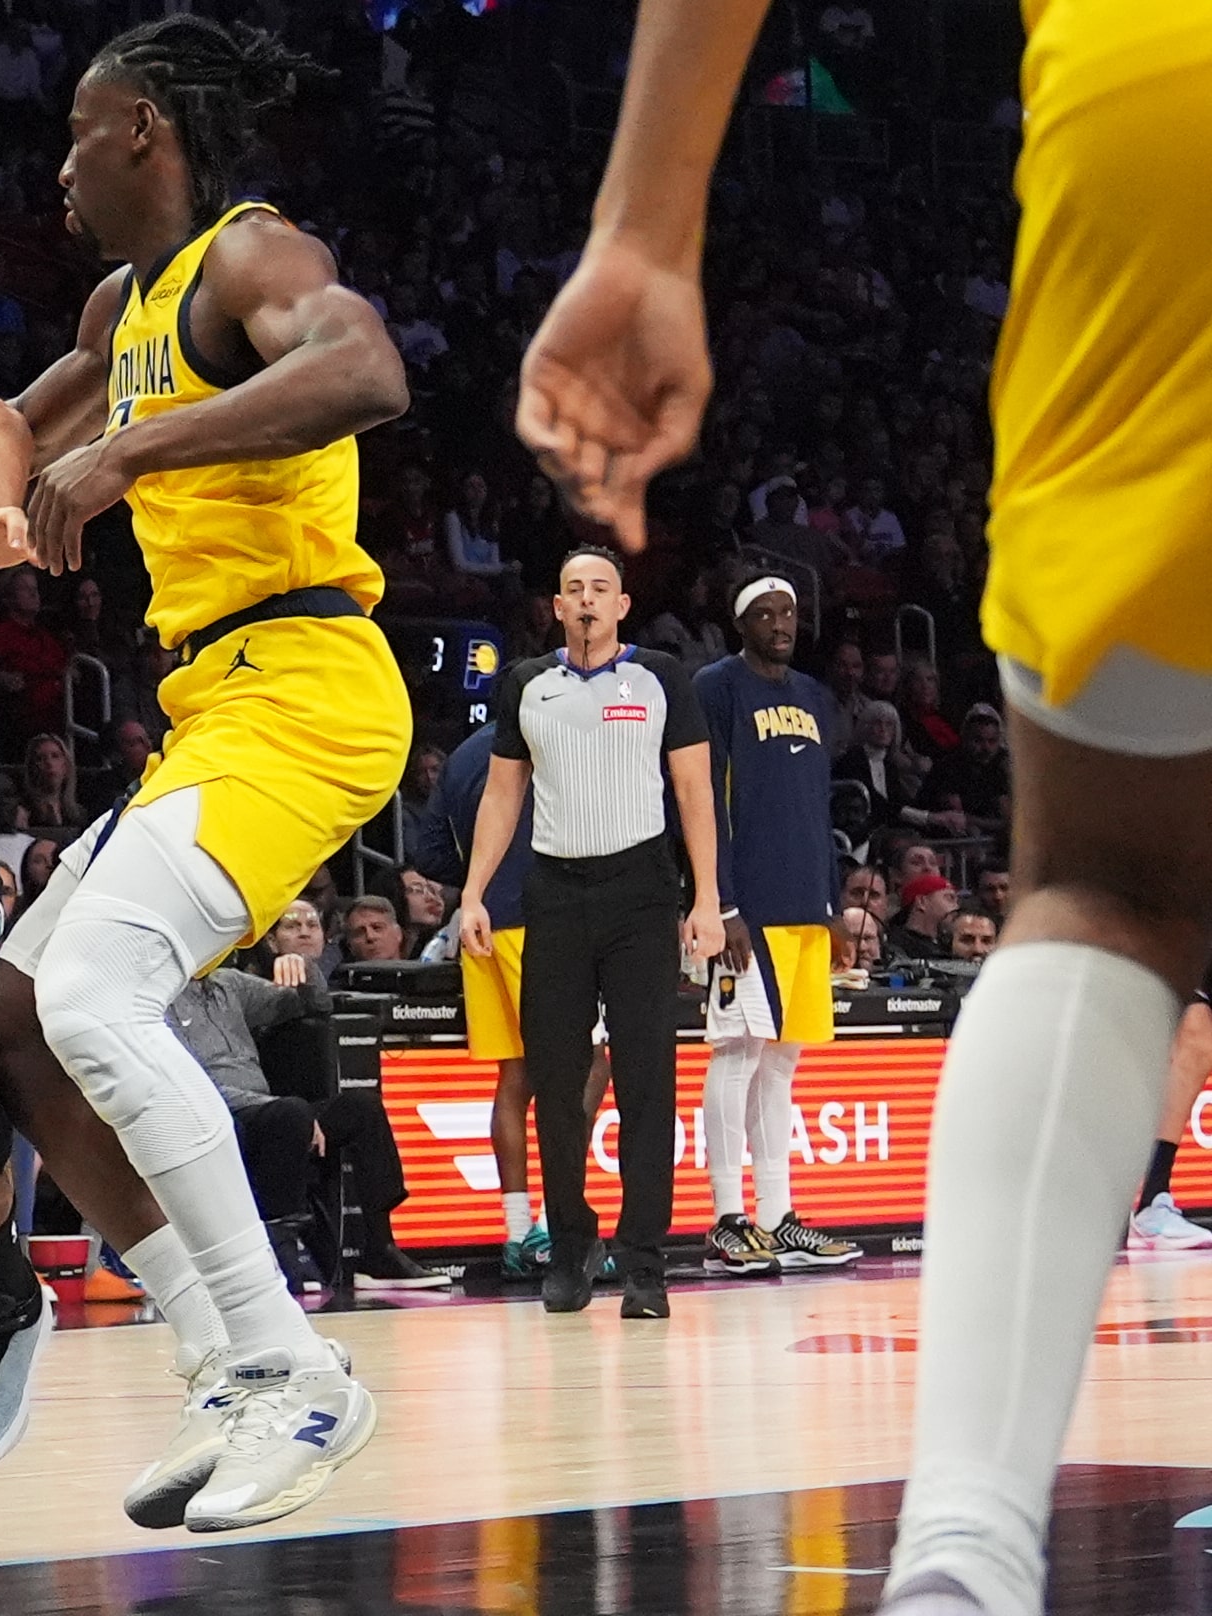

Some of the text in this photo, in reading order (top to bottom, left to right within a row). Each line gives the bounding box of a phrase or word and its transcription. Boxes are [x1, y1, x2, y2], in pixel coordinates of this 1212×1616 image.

[603, 708, 646, 719] Emirates
[753, 705, 821, 745] PACERS
[392, 1004, 457, 1019] ticketmaster
[887, 997, 942, 1012] ticketmaster
